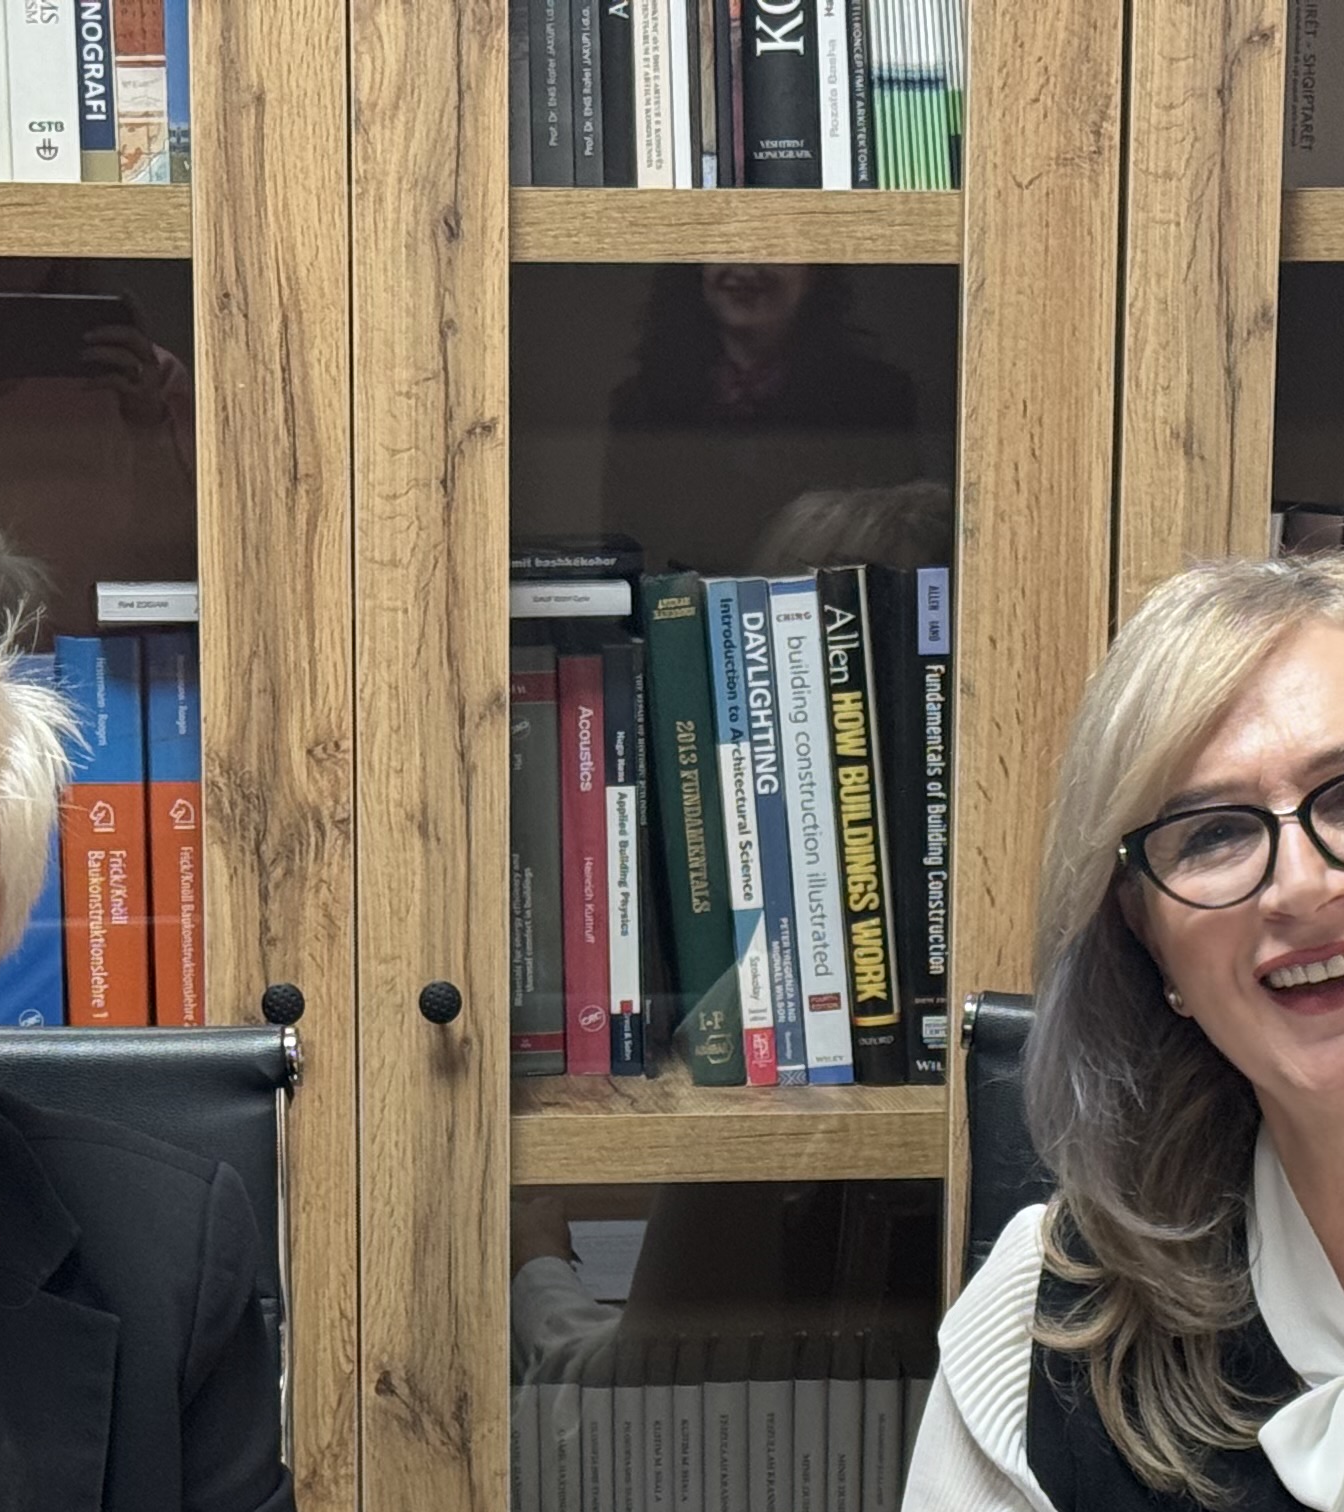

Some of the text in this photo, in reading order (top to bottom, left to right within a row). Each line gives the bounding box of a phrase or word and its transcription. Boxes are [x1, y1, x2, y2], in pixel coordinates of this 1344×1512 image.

[29, 120, 66, 133] CSTB
[775, 611, 812, 623] CHING
[927, 584, 941, 611] ALLEN
[740, 611, 779, 796] DAYLIGHTING
[785, 633, 814, 726] building
[924, 663, 946, 777] Fundamentals
[577, 704, 596, 792] Acoustics
[717, 598, 757, 902] Introduction to Architectural Science
[793, 730, 825, 866] construction
[925, 780, 947, 800] of
[675, 720, 712, 914] 2013 FUNDAMENTALS
[823, 603, 889, 1003] Allen HOW BUILDINGS WORK
[921, 803, 947, 867] Building
[108, 849, 128, 925] Frick/Knöll
[614, 792, 631, 937] Applied Building Physics
[87, 849, 110, 1009] Baukonstruktionslehre
[179, 846, 197, 1021] Frick/Knöll Baukonstruktionslehre
[807, 871, 835, 979] illustrated
[925, 869, 948, 976] Construction
